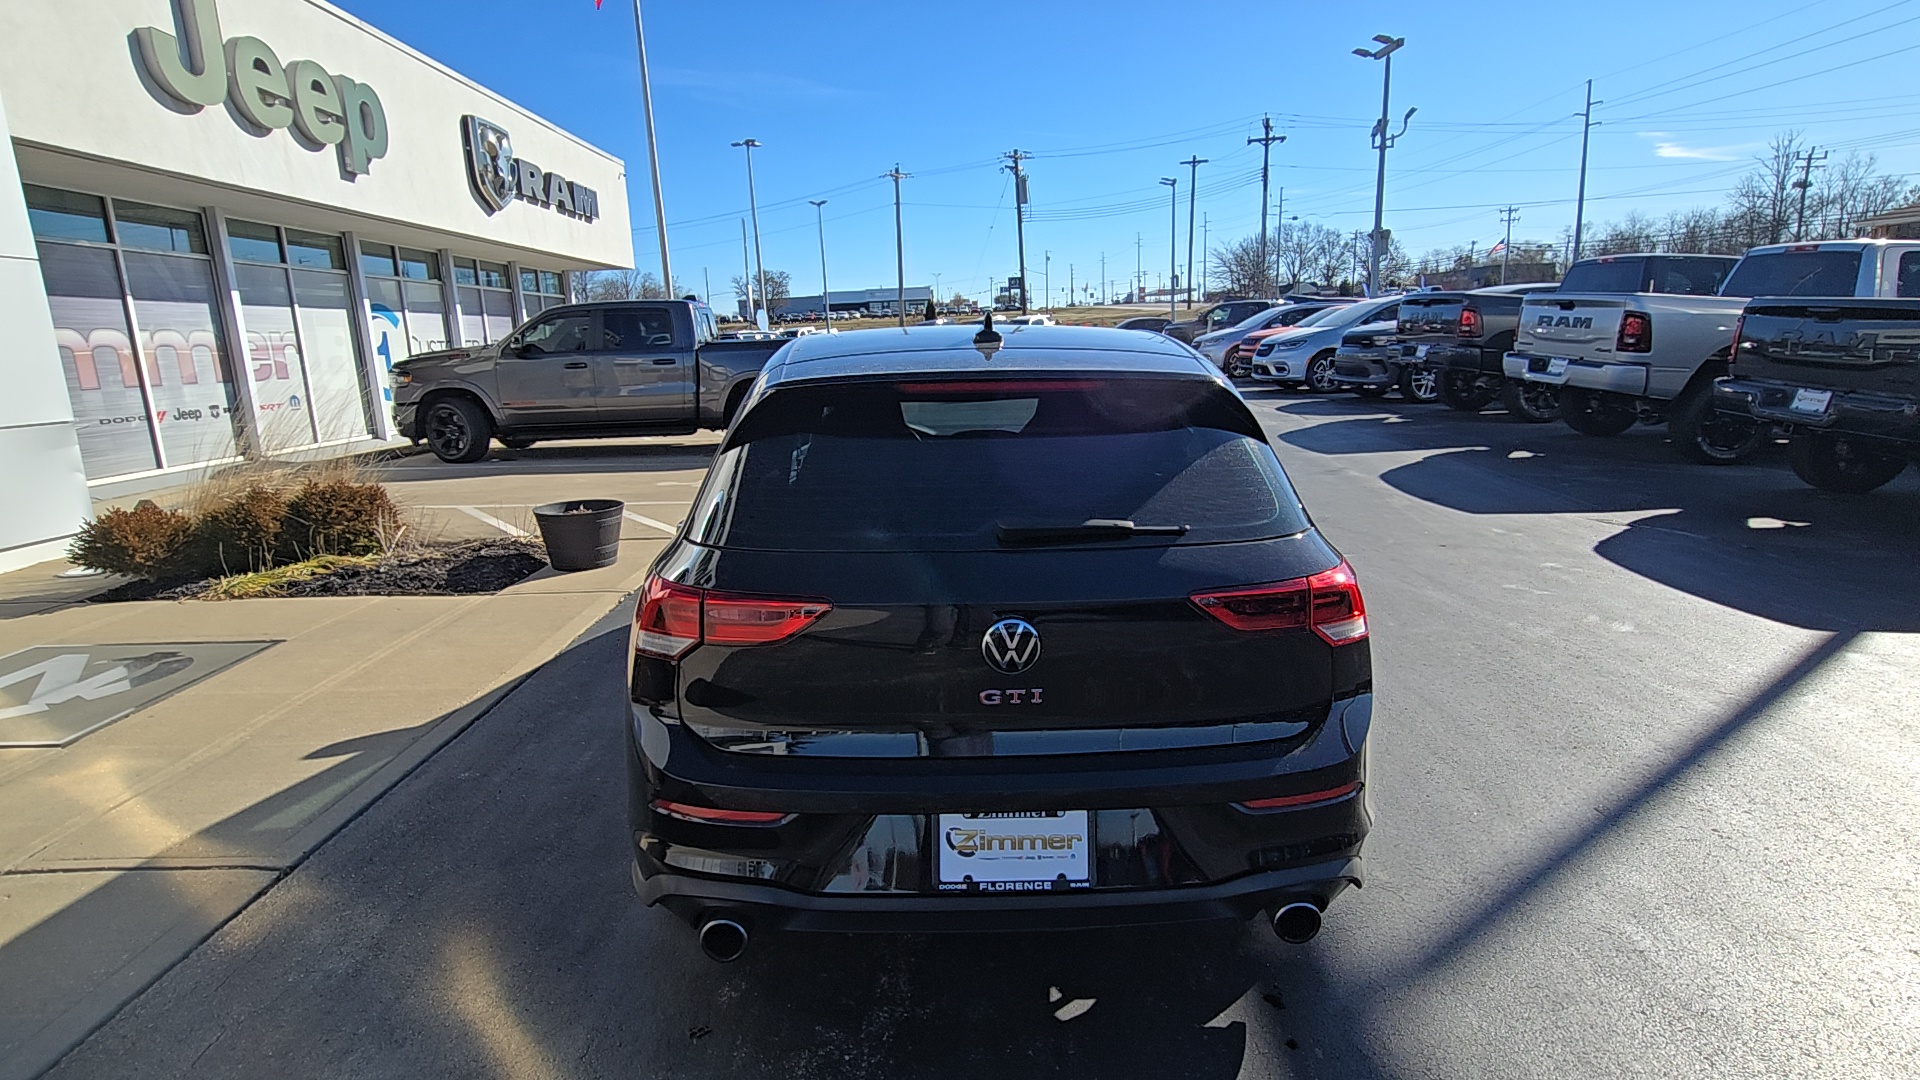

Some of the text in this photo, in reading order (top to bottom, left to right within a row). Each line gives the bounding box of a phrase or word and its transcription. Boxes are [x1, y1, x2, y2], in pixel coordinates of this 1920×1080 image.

[136, 0, 389, 180] Jeep
[514, 158, 600, 223] RAM
[1536, 315, 1594, 329] RAM
[1771, 328, 1880, 351] RAM
[172, 407, 203, 422] Jeep
[979, 688, 1043, 705] GTI
[954, 829, 1083, 851] Zimmer
[979, 881, 1052, 891] FLORENCE
